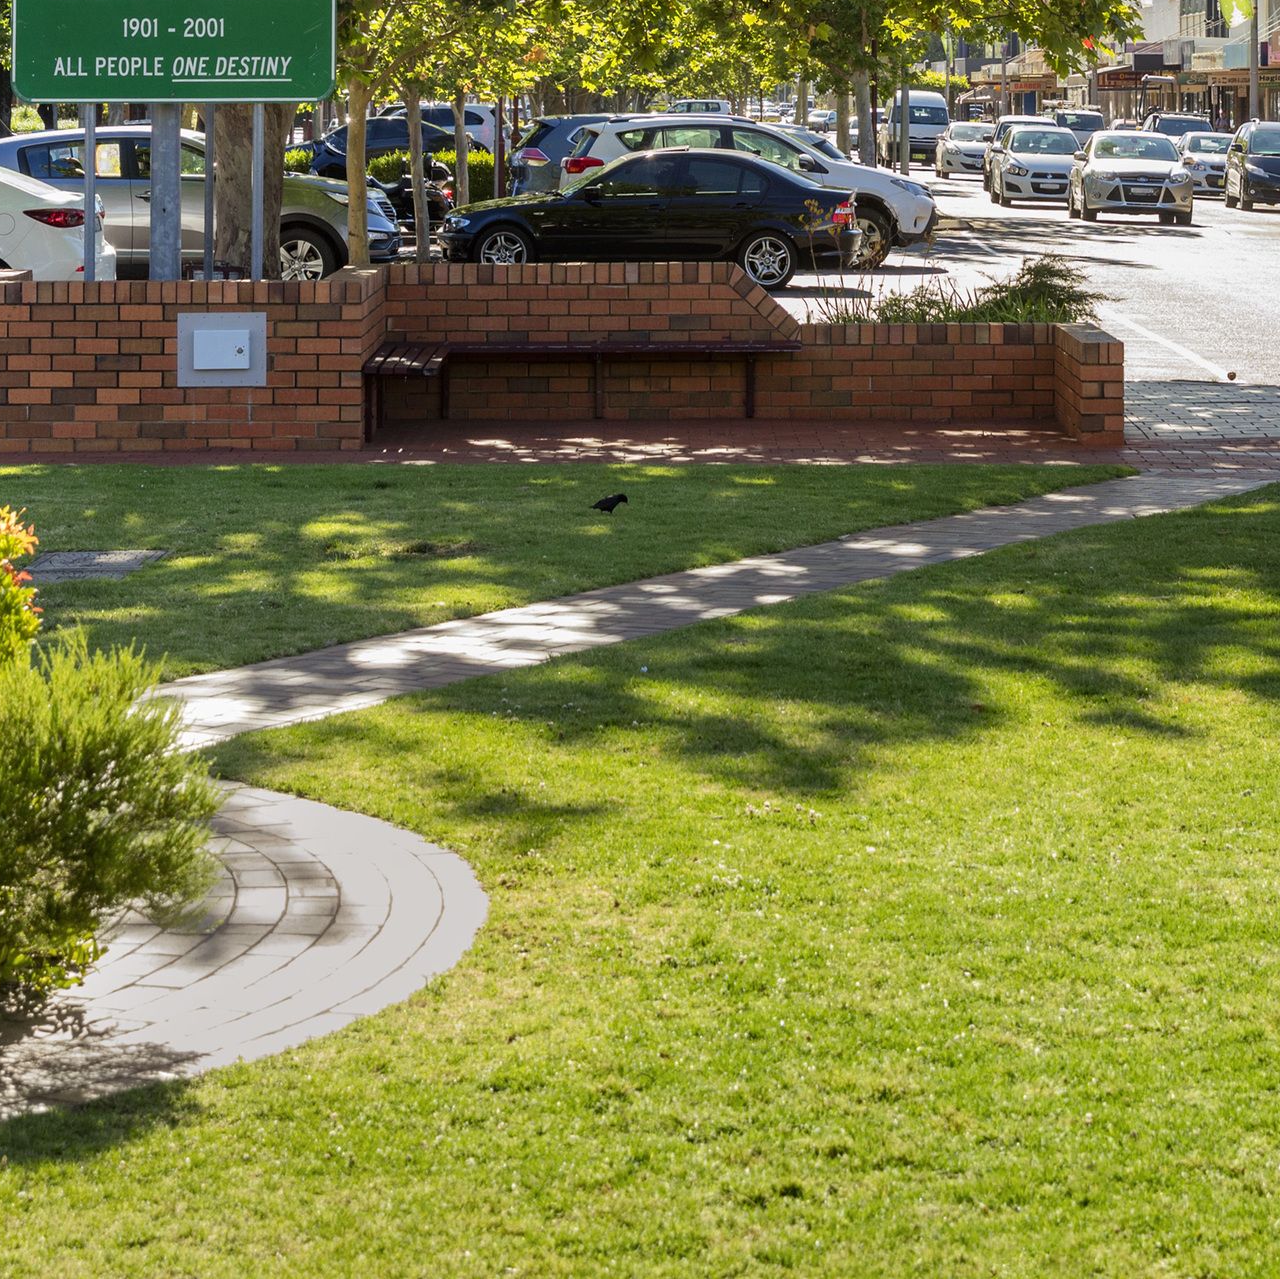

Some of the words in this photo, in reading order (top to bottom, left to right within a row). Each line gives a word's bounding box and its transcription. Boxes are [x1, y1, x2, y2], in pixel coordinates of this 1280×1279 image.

[122, 18, 158, 38] 1901
[184, 18, 225, 38] 2001
[54, 56, 88, 76] ALL
[96, 56, 163, 76] PEOPLE
[172, 56, 208, 76] ONE
[215, 56, 292, 76] DESTINY
